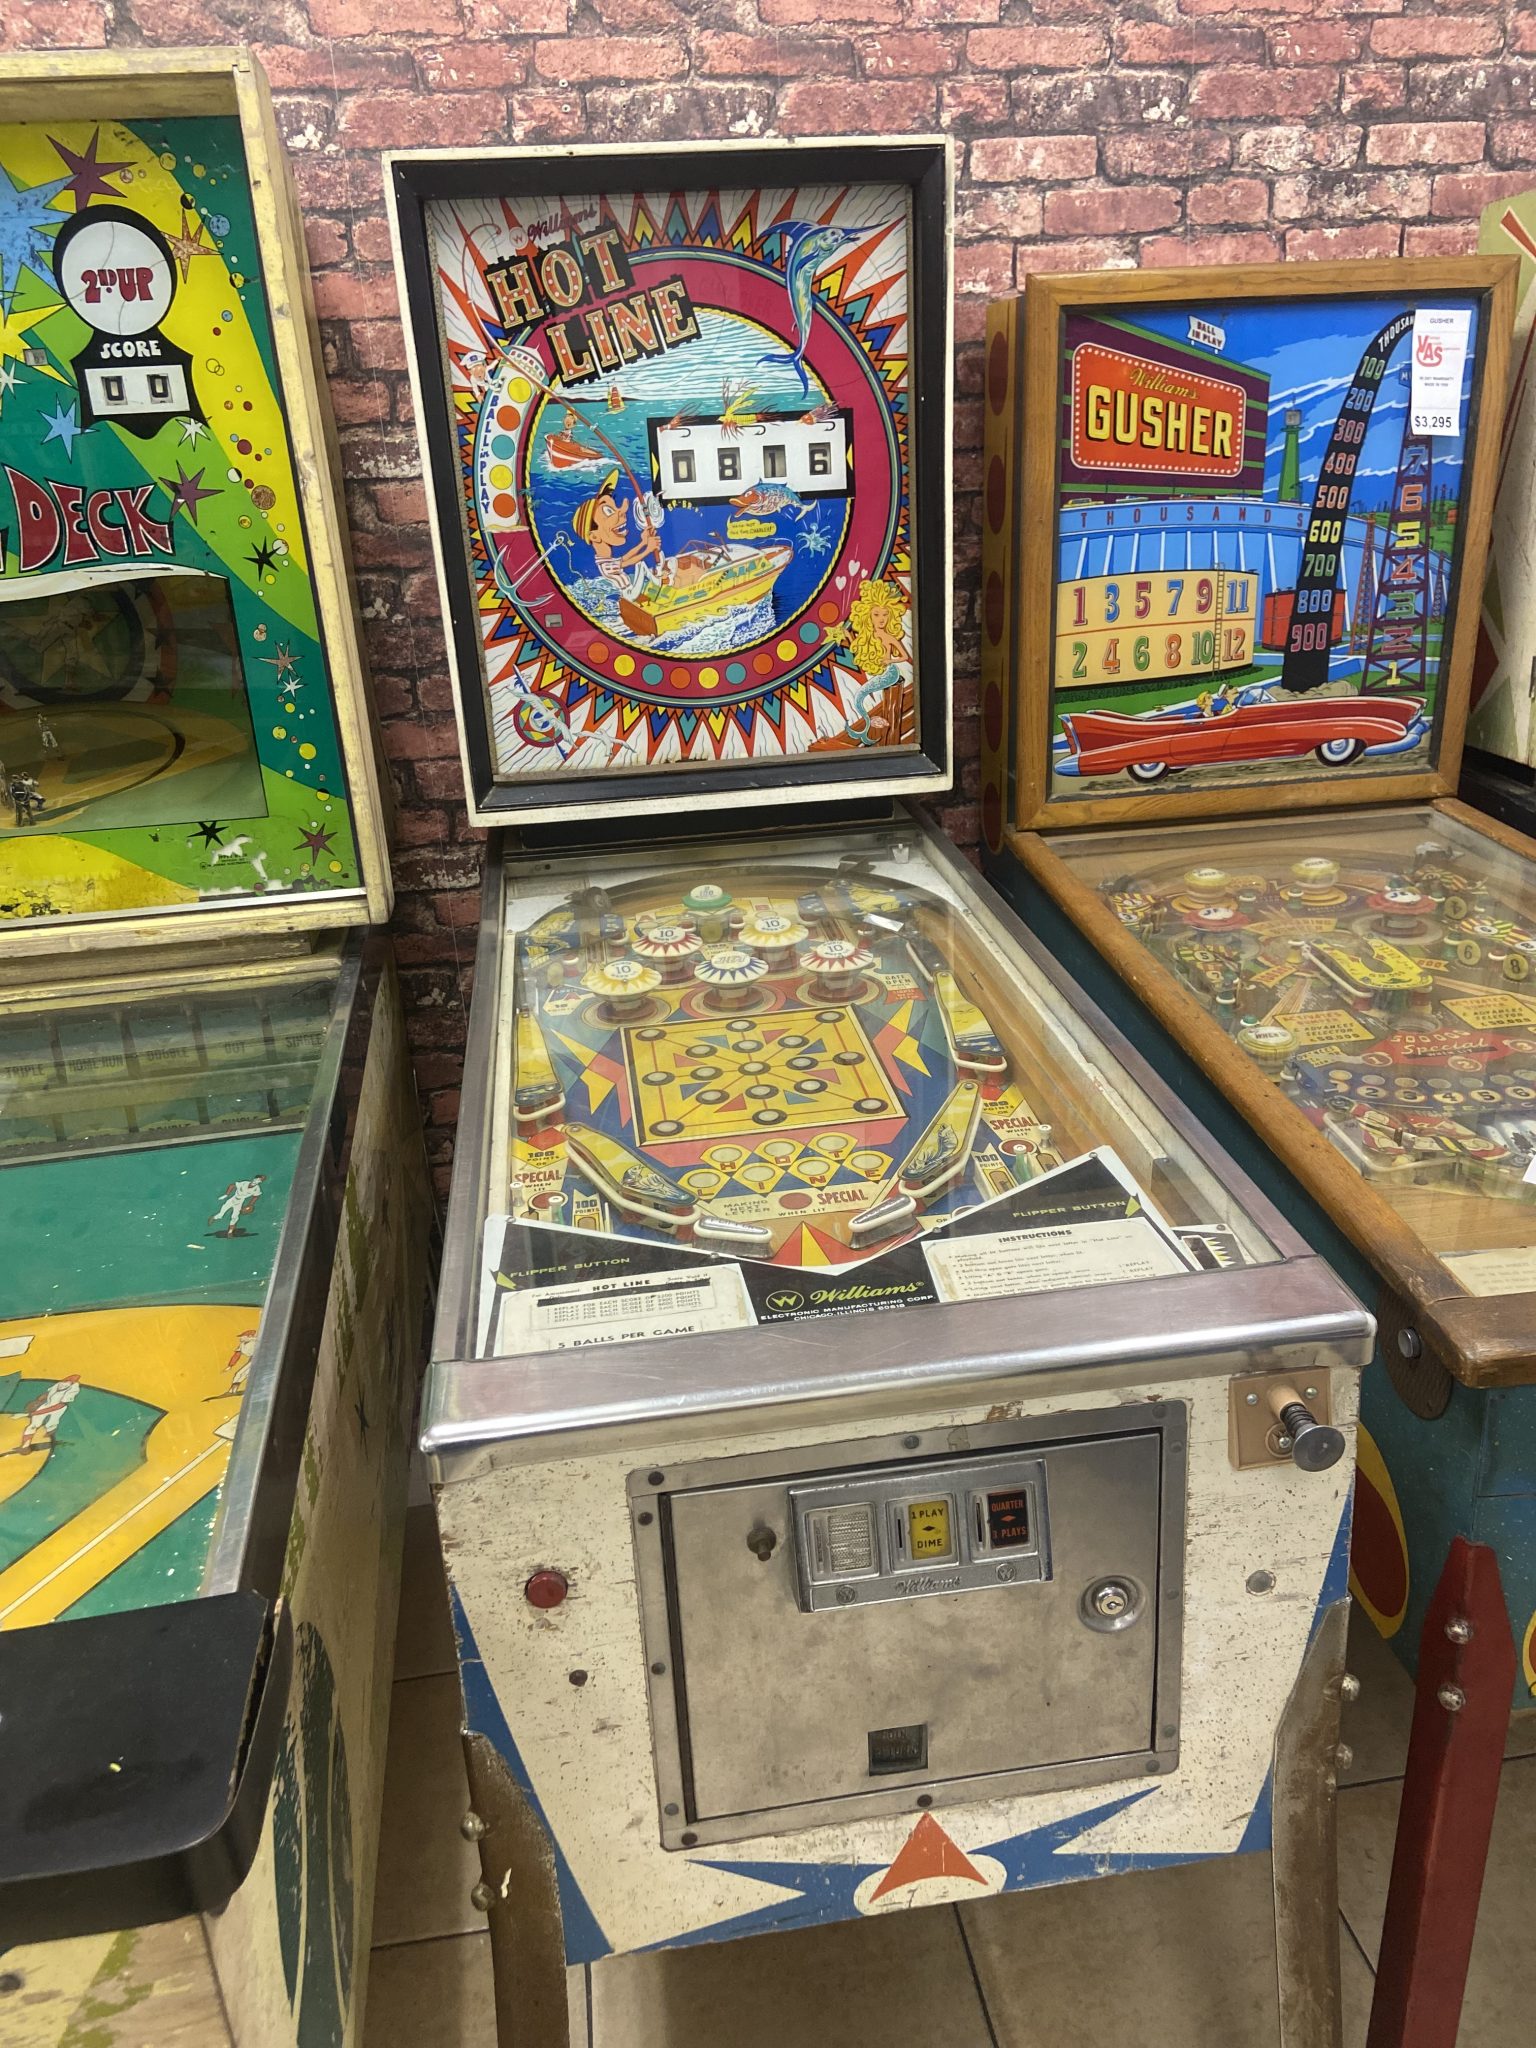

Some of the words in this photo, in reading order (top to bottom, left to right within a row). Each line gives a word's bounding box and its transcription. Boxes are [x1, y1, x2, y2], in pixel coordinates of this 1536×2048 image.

[527, 202, 597, 242] Williams
[118, 267, 154, 302] UP
[487, 228, 626, 330] HOT
[546, 281, 698, 384] LINE
[1196, 321, 1216, 336] BALL
[1202, 332, 1222, 347] PLAY
[1378, 315, 1416, 352] THOUSAN
[100, 340, 162, 359] SCORE
[1359, 356, 1386, 380] 100
[1129, 367, 1199, 399] Williams
[1345, 387, 1374, 412] 200
[483, 395, 500, 448] BALL
[1085, 383, 1233, 459] GUSHER
[1333, 418, 1365, 444] 300
[1414, 415, 1453, 429] $3,295
[1324, 451, 1356, 475] 400
[480, 460, 491, 515] PLAY
[1315, 484, 1349, 510] 500
[1399, 484, 1424, 511] 6
[3, 464, 174, 572] DECK
[1309, 520, 1342, 545] 600
[1396, 521, 1421, 547] 5
[1304, 553, 1336, 578] 700
[1390, 556, 1416, 582] 4
[1072, 586, 1088, 626] 1
[1103, 582, 1121, 623] 3
[1134, 580, 1153, 618] 5
[1165, 579, 1185, 615] 7
[1195, 578, 1214, 614] 9
[1224, 578, 1250, 614] 11
[1298, 588, 1332, 614] 800
[1290, 622, 1328, 652] 900
[1072, 641, 1088, 678] 2
[1101, 638, 1121, 674] 4
[1132, 636, 1150, 671] 6
[1163, 633, 1182, 669] 8
[1191, 630, 1216, 666] 10
[1221, 627, 1247, 662] 12
[1385, 660, 1401, 686] 1
[659, 930, 674, 938] 10
[765, 919, 780, 928] 10
[828, 945, 844, 953] 10
[615, 965, 632, 975] 10
[223, 1041, 247, 1055] OUT
[1401, 1038, 1489, 1056] Special
[989, 1116, 1039, 1131] SPECIAL
[528, 1150, 555, 1158] 100
[975, 1153, 999, 1163] 100
[514, 1169, 562, 1183] SPECIAL
[575, 1200, 598, 1209] 100
[816, 1188, 869, 1206] SPECIAL
[778, 1209, 808, 1217] WHEN
[1012, 1206, 1067, 1218] FLIPPER
[1072, 1201, 1126, 1211] BUTTON
[997, 1229, 1073, 1243] INSTRUCTIONS
[510, 1265, 568, 1279] FLIPPER
[574, 1257, 630, 1270] BUTTON
[592, 1283, 617, 1292] HOT
[622, 1279, 651, 1288] LINE
[760, 1309, 820, 1321] ELECTRONIC
[823, 1298, 904, 1313] MANUFACTURING
[558, 1341, 566, 1349] 5
[573, 1334, 615, 1347] BALLS
[621, 1329, 646, 1340] PER
[653, 1325, 695, 1337] GAME
[911, 1511, 917, 1520] 1
[919, 1507, 944, 1519] PLAY
[990, 1499, 1024, 1512] QUARTER
[917, 1537, 943, 1549] DIME
[1001, 1525, 1027, 1538] PLAYS
